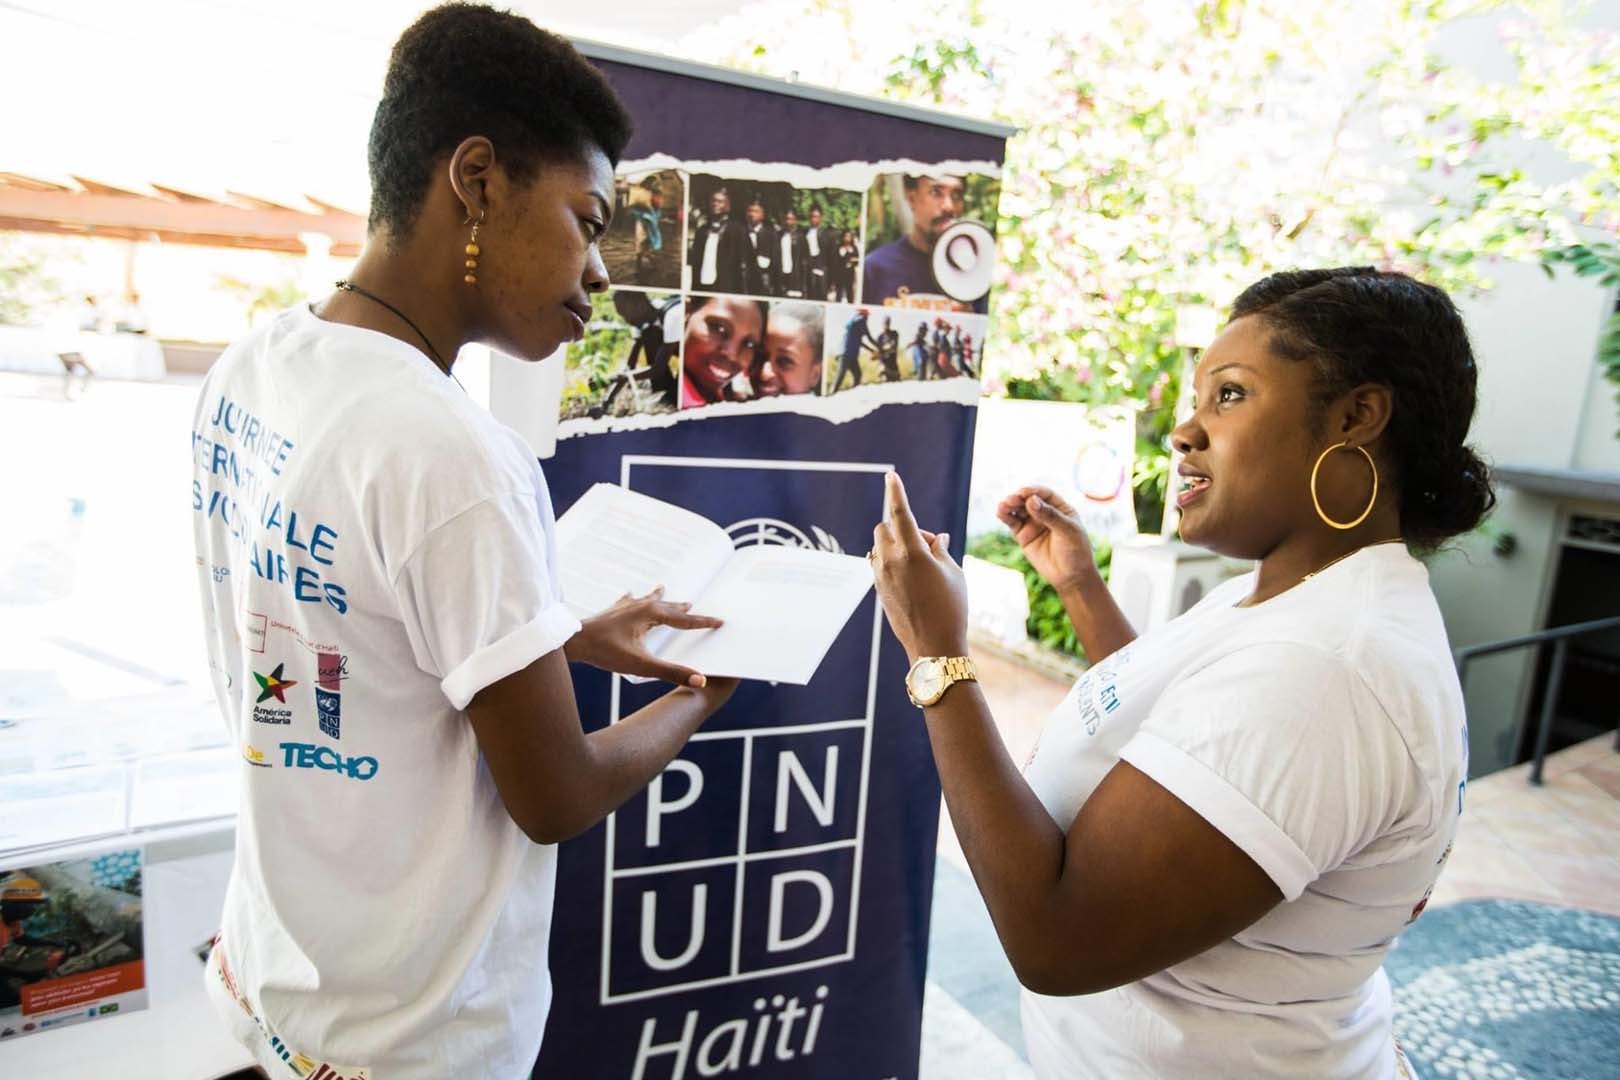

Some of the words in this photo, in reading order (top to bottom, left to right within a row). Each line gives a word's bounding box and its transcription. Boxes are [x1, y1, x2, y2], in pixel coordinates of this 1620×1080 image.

[253, 713, 291, 725] Solidaria
[279, 742, 379, 780] TECHO
[631, 985, 829, 1080] Haïti
